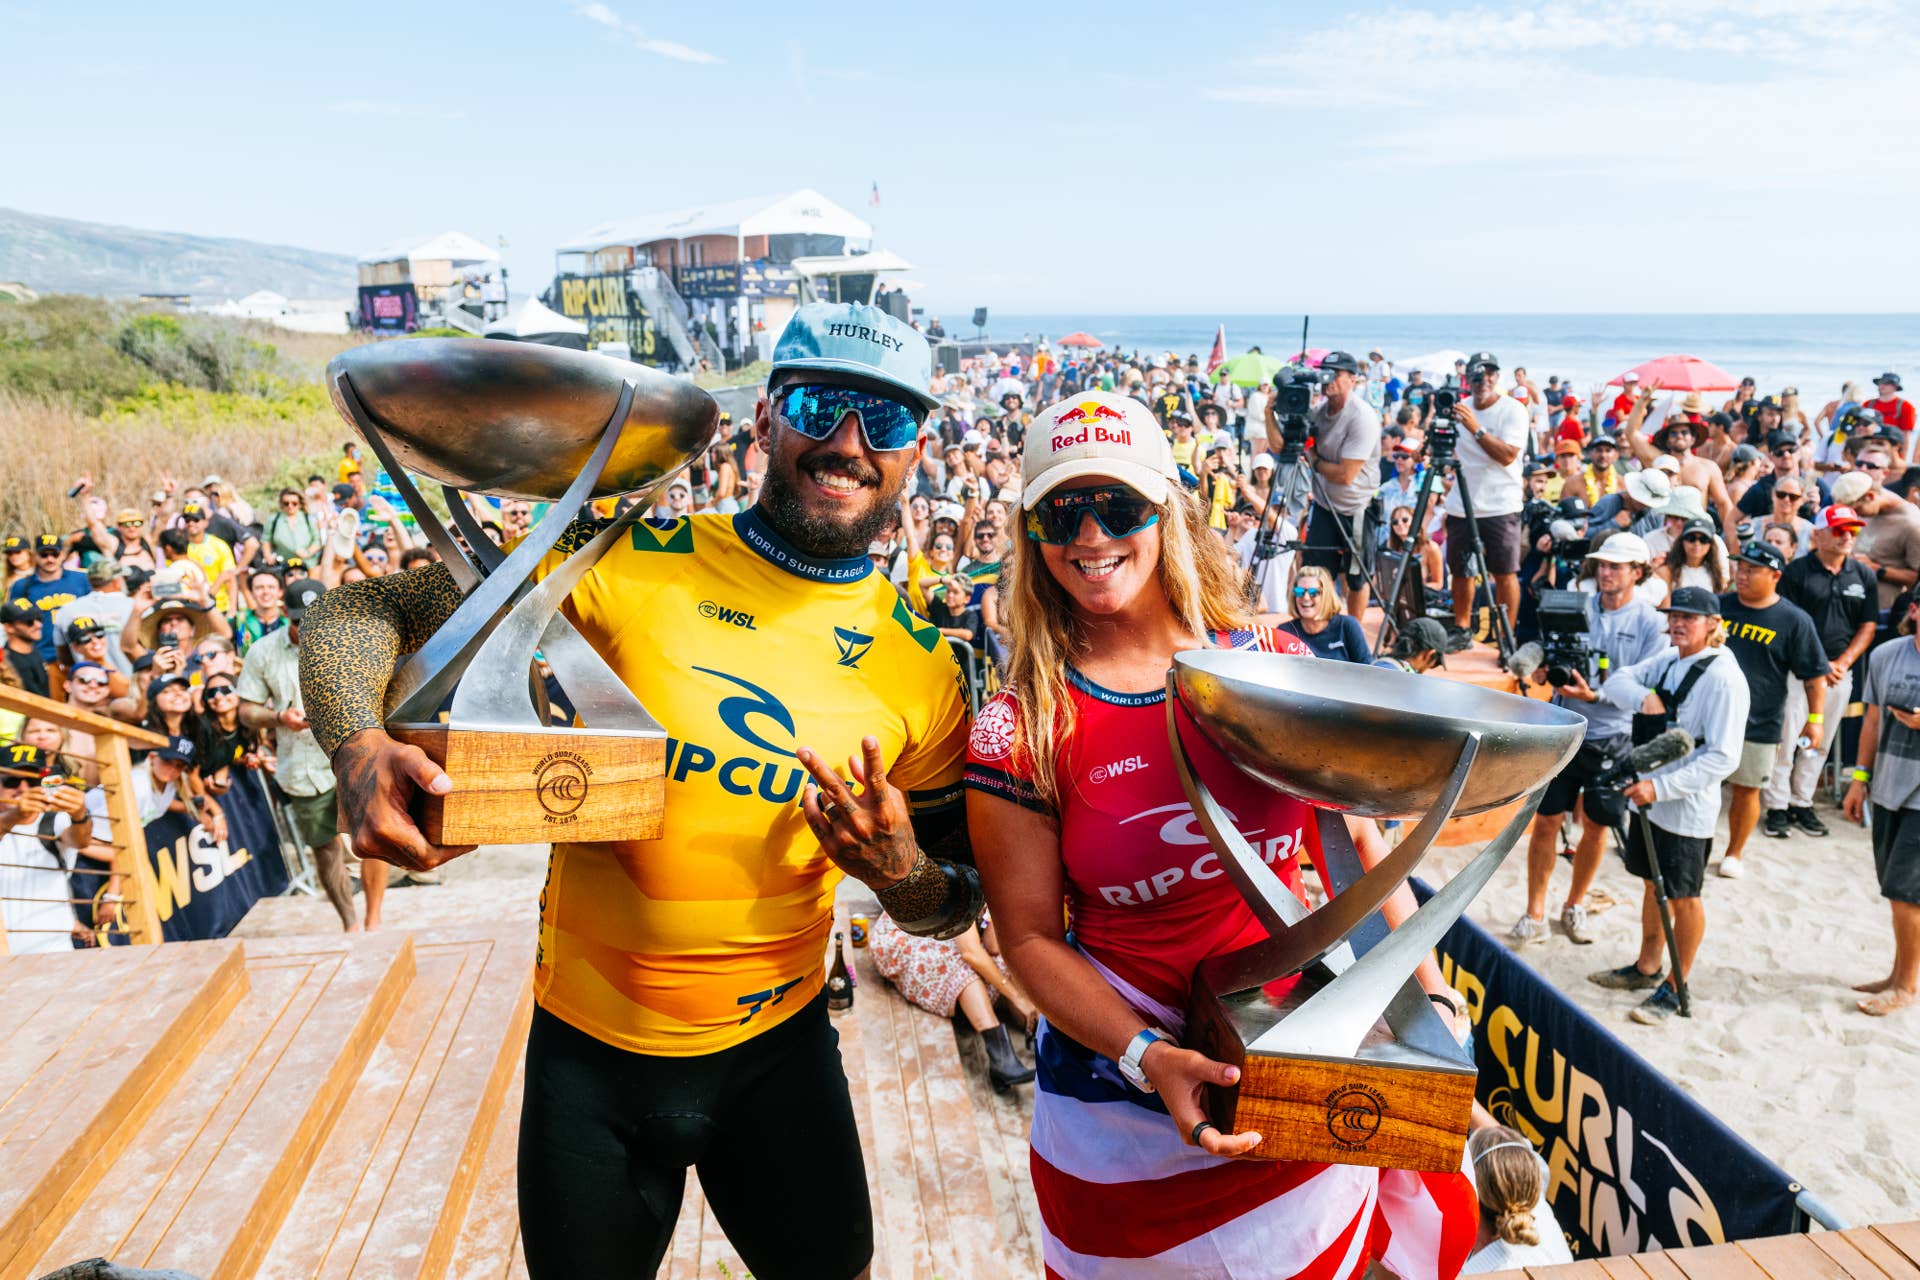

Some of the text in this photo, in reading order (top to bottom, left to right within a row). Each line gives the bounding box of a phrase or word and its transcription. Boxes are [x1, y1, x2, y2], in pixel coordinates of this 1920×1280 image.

[829, 323, 904, 353] HURLEY
[1051, 427, 1132, 452] Red Bull
[747, 527, 865, 579] WORLD SURF LEAGUE
[718, 606, 757, 631] WSL
[1740, 623, 1777, 646] FT77
[1101, 692, 1167, 705] WORLD SUR
[532, 750, 594, 777] WORLD SURF LEAGUE
[666, 737, 716, 783] IP
[1107, 755, 1149, 778] WSL
[964, 773, 1004, 790] IONSHIP
[149, 824, 248, 922] WSL
[1098, 827, 1303, 906] RIP CRL
[1432, 946, 1647, 1215] IP CURL
[1325, 1085, 1347, 1104] WORLD
[1545, 1136, 1663, 1257] FIN
